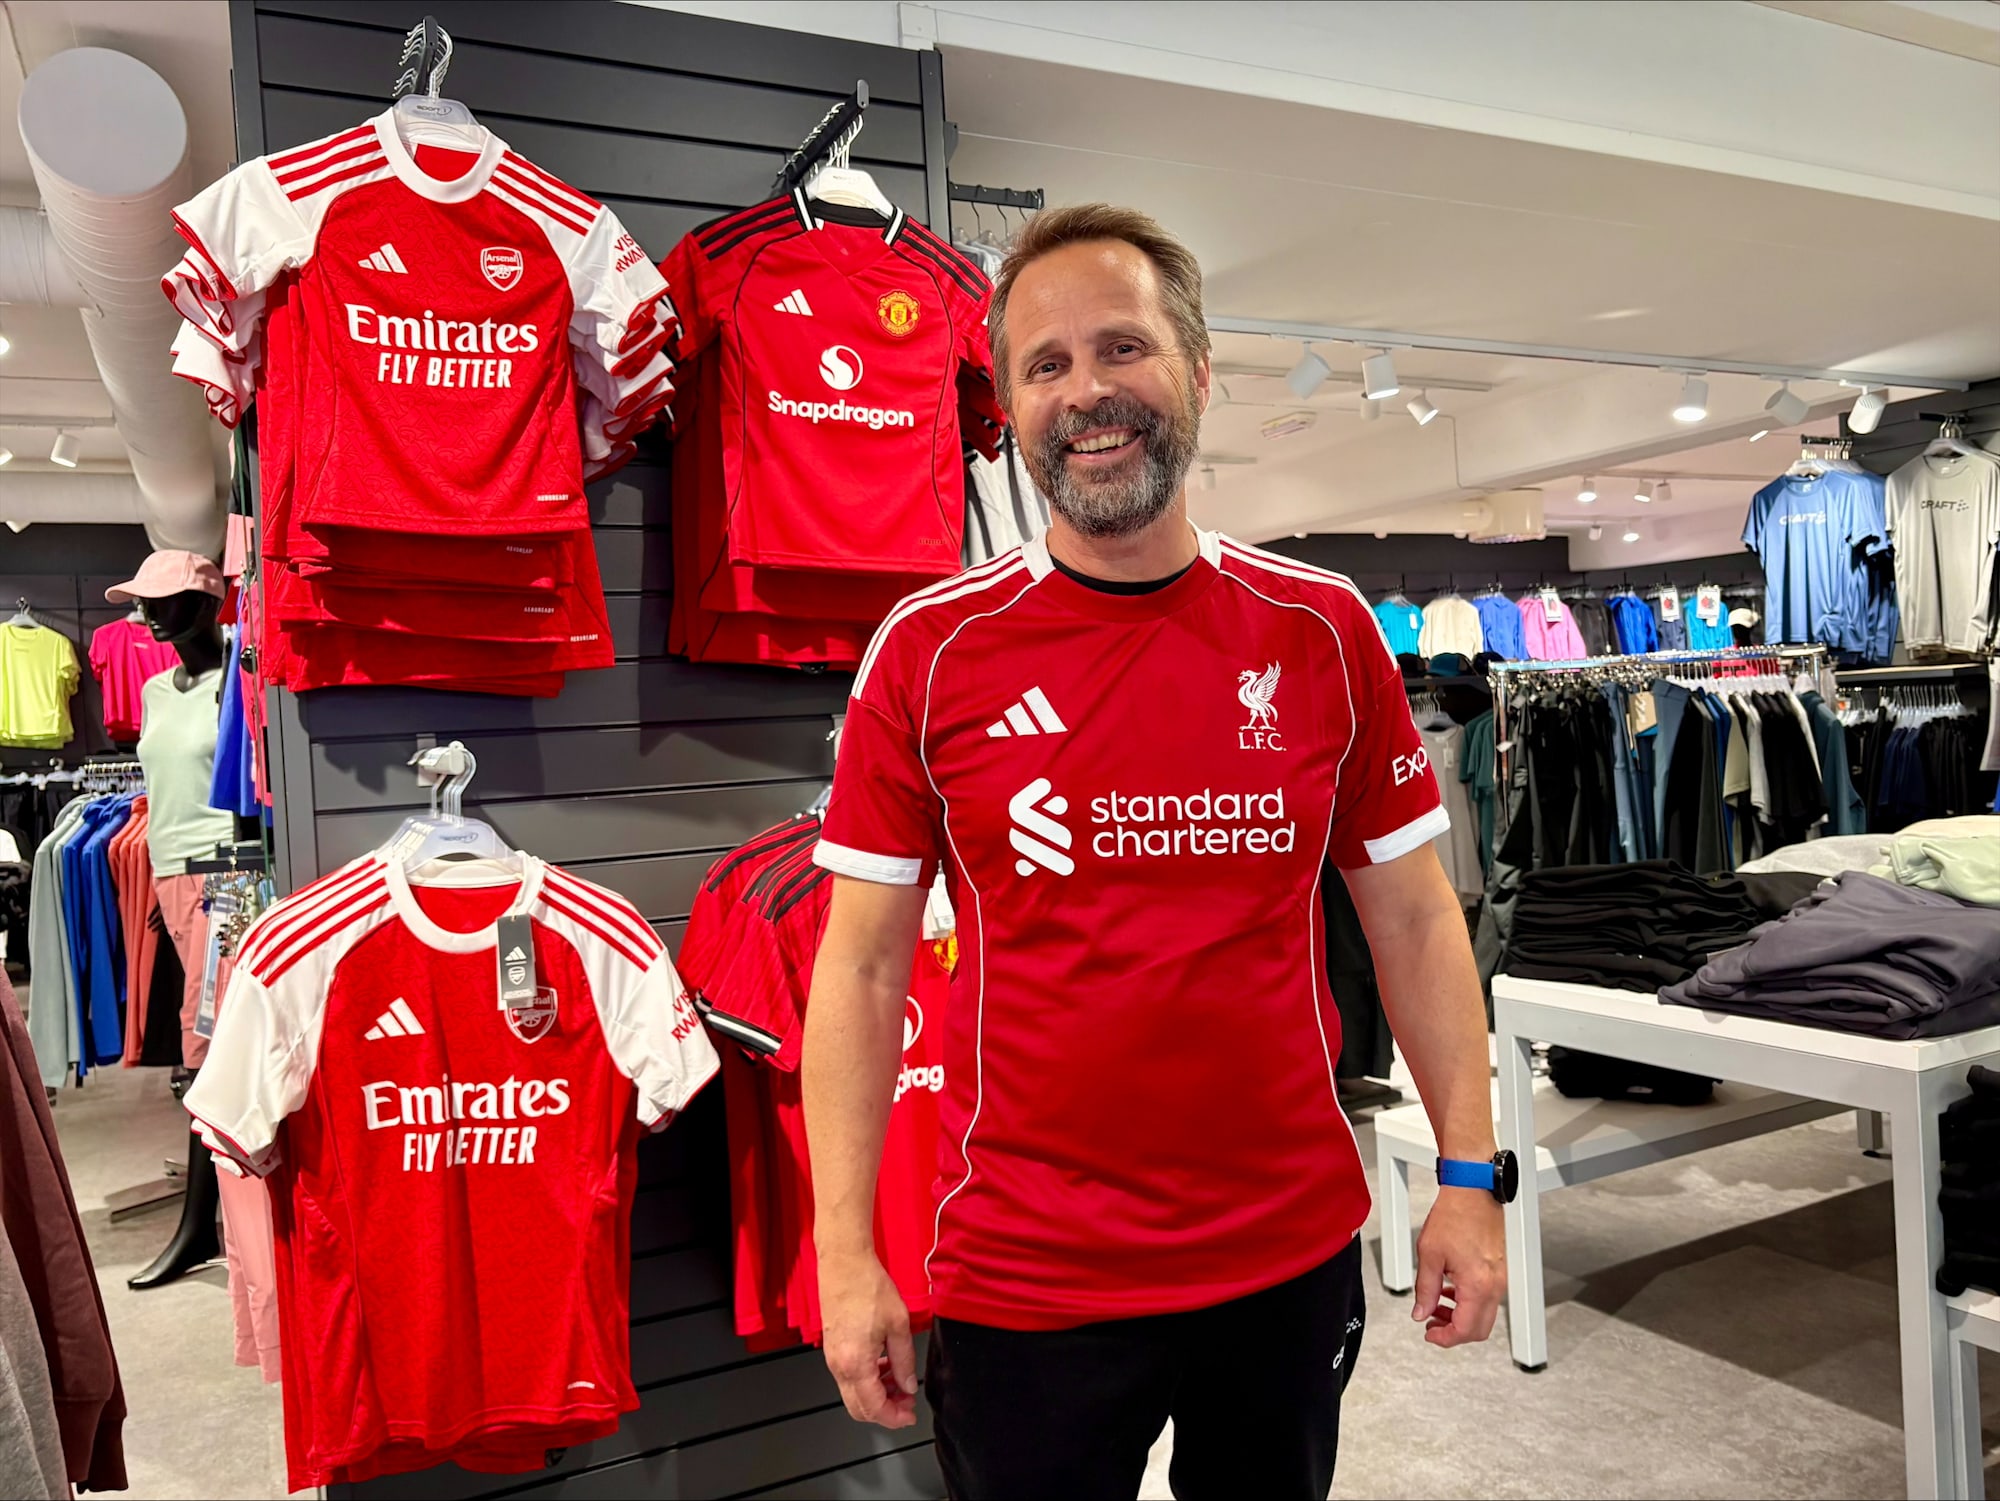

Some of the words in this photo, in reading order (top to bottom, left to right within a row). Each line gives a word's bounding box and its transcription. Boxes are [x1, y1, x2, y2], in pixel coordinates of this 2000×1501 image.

[486, 254, 517, 263] Arsenal
[344, 303, 539, 354] Emirates
[377, 352, 419, 385] FLY
[426, 357, 513, 389] BETTER
[768, 390, 915, 430] Snapdragon
[1920, 500, 1957, 511] CRAFT
[1090, 786, 1285, 824] standard
[1092, 820, 1296, 858] chartered
[360, 1072, 571, 1131] Emirates
[403, 1132, 442, 1173] FLY
[446, 1126, 538, 1168] BETTER
